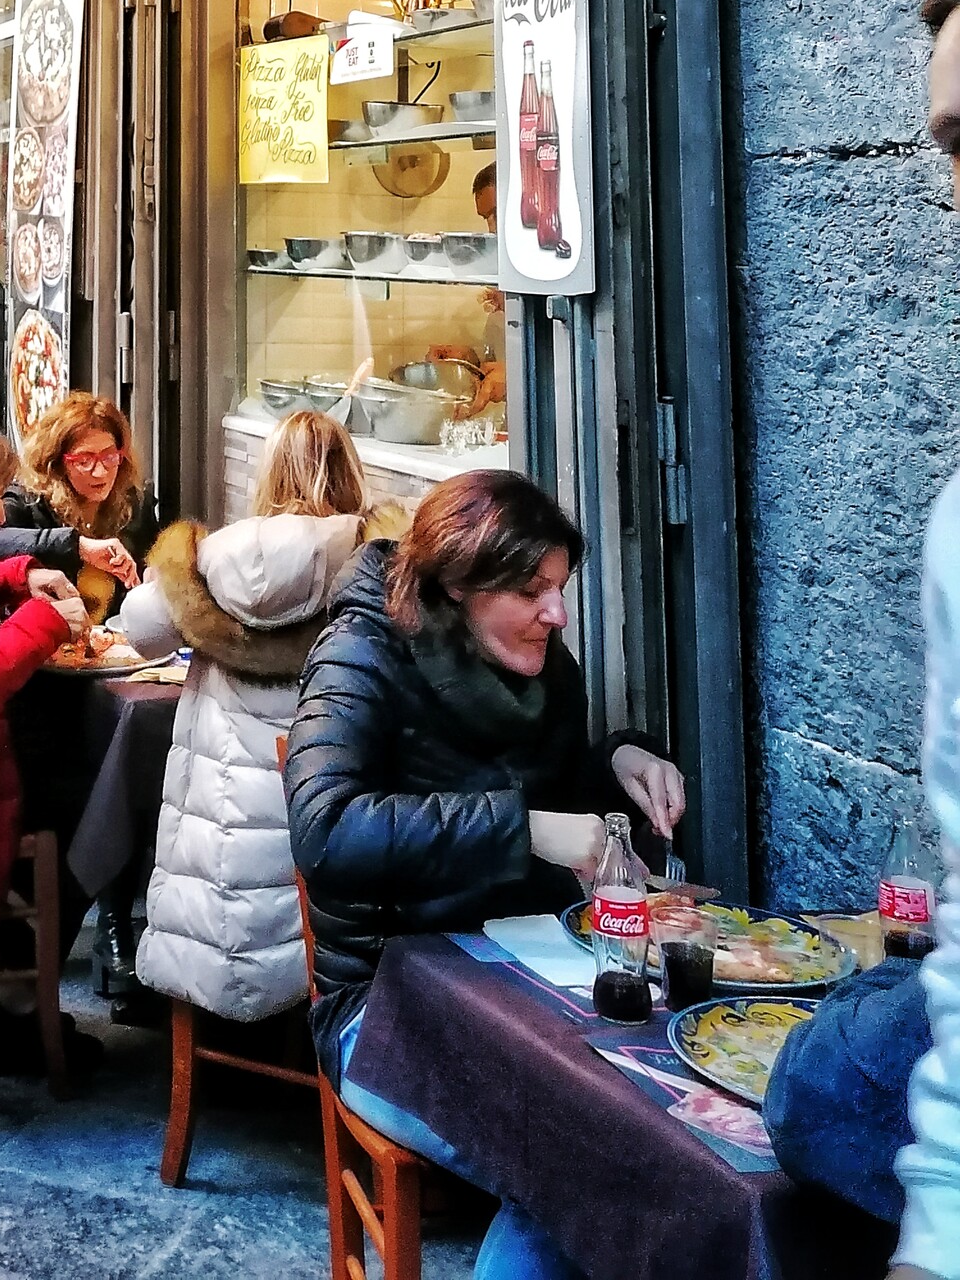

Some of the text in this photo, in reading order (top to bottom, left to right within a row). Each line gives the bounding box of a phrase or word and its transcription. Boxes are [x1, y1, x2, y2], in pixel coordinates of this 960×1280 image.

[345, 46, 358, 59] JUST
[348, 56, 358, 67] EAT
[241, 48, 287, 82] Pizza
[272, 126, 317, 165] Pizza
[599, 912, 645, 934] Coca-Cola
